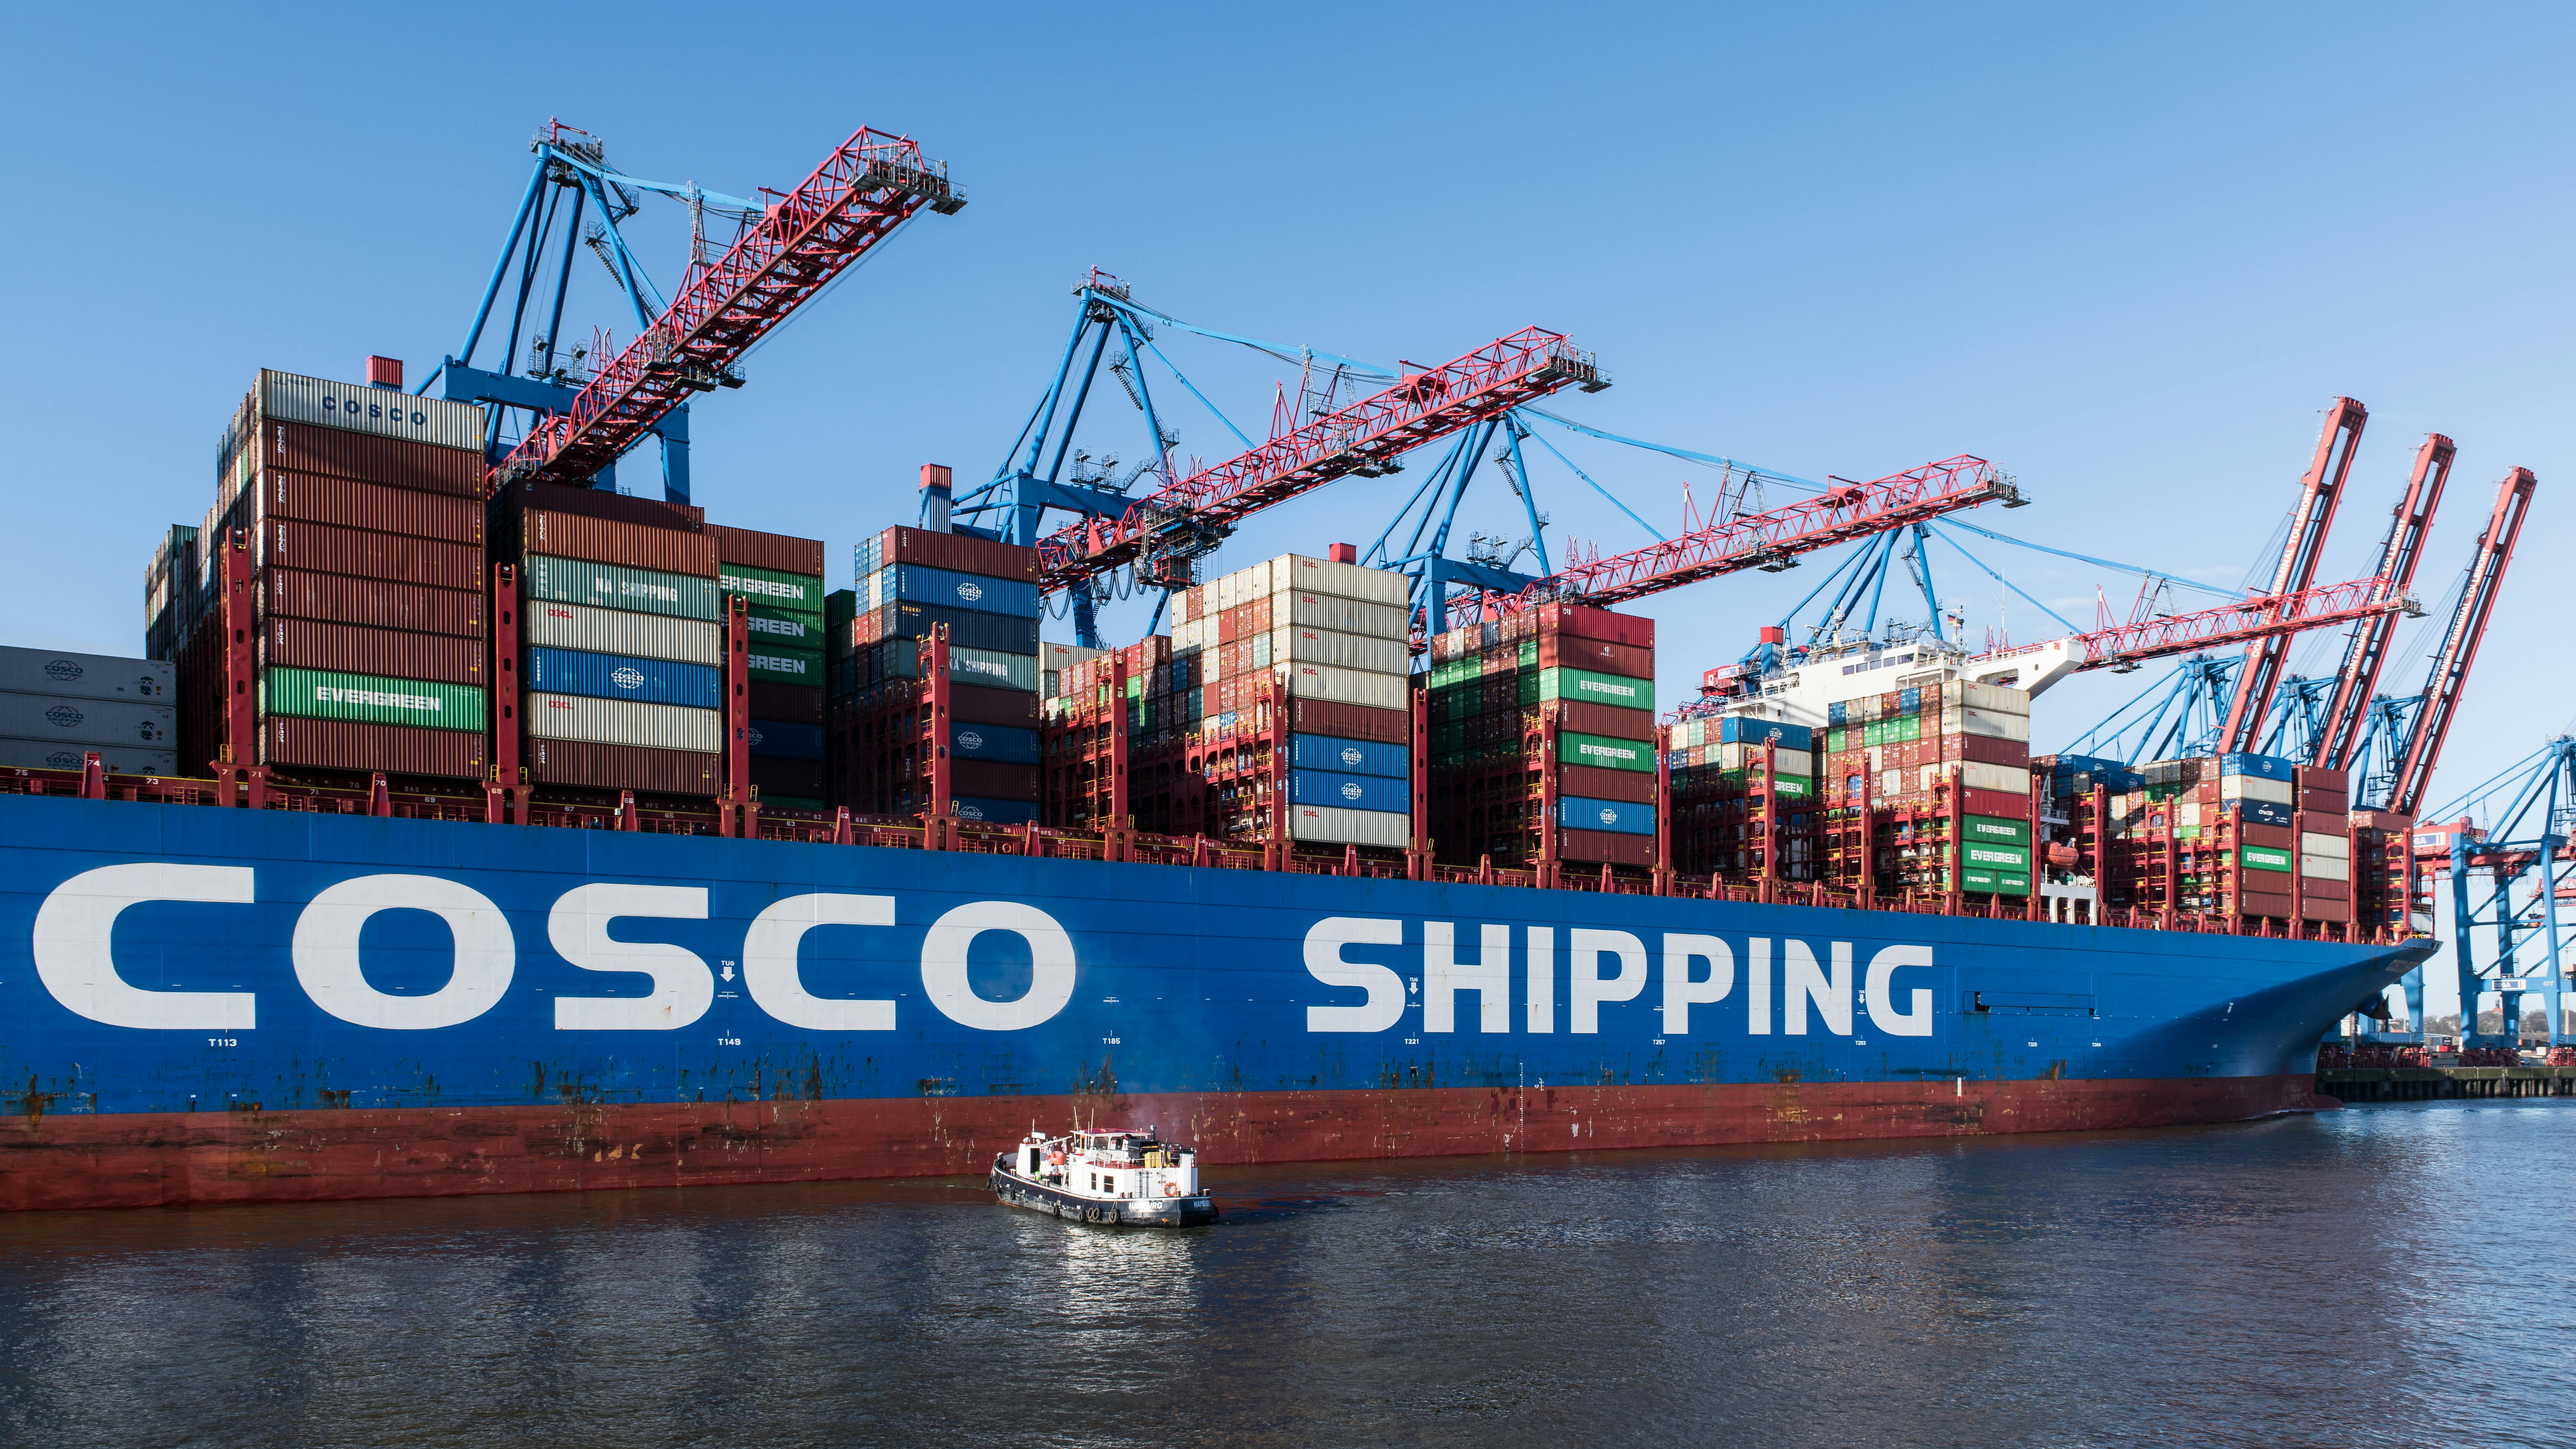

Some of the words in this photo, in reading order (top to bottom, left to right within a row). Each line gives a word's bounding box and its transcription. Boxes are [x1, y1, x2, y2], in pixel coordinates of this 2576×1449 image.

[322, 396, 426, 425] COSCO
[2271, 546, 2294, 597] TERMINAL
[2289, 487, 2314, 546] TOLLERORT
[621, 581, 678, 602] SHIPPING
[720, 575, 804, 600] ERGREEN
[957, 587, 982, 595] COSCO
[2346, 627, 2369, 680] CONTAINER
[2381, 518, 2407, 573] TOLLERORT
[747, 617, 804, 637] GREEN
[2431, 649, 2454, 700] CONTAINER
[2449, 601, 2472, 646] TERMINAL
[2466, 547, 2490, 598] TOLLERORT
[44, 665, 83, 674] COSCO
[747, 654, 805, 674] GREEN
[966, 660, 1007, 676] SHIPPING
[611, 672, 644, 681] COSCO
[1580, 680, 1634, 697] EVERGREEN
[316, 686, 441, 711] EVERGREEN
[45, 711, 84, 719] COSCO
[1580, 744, 1635, 760] EVERGREEN
[46, 756, 84, 765] COSCO
[1774, 781, 1802, 793] GREEN
[1977, 824, 2016, 836] EVERGREEN
[1971, 850, 2021, 864] EVERGREEN
[2247, 852, 2285, 865] EVERGREEN
[33, 862, 1076, 1030] COSCO
[1303, 917, 1932, 1036] SHIPPING
